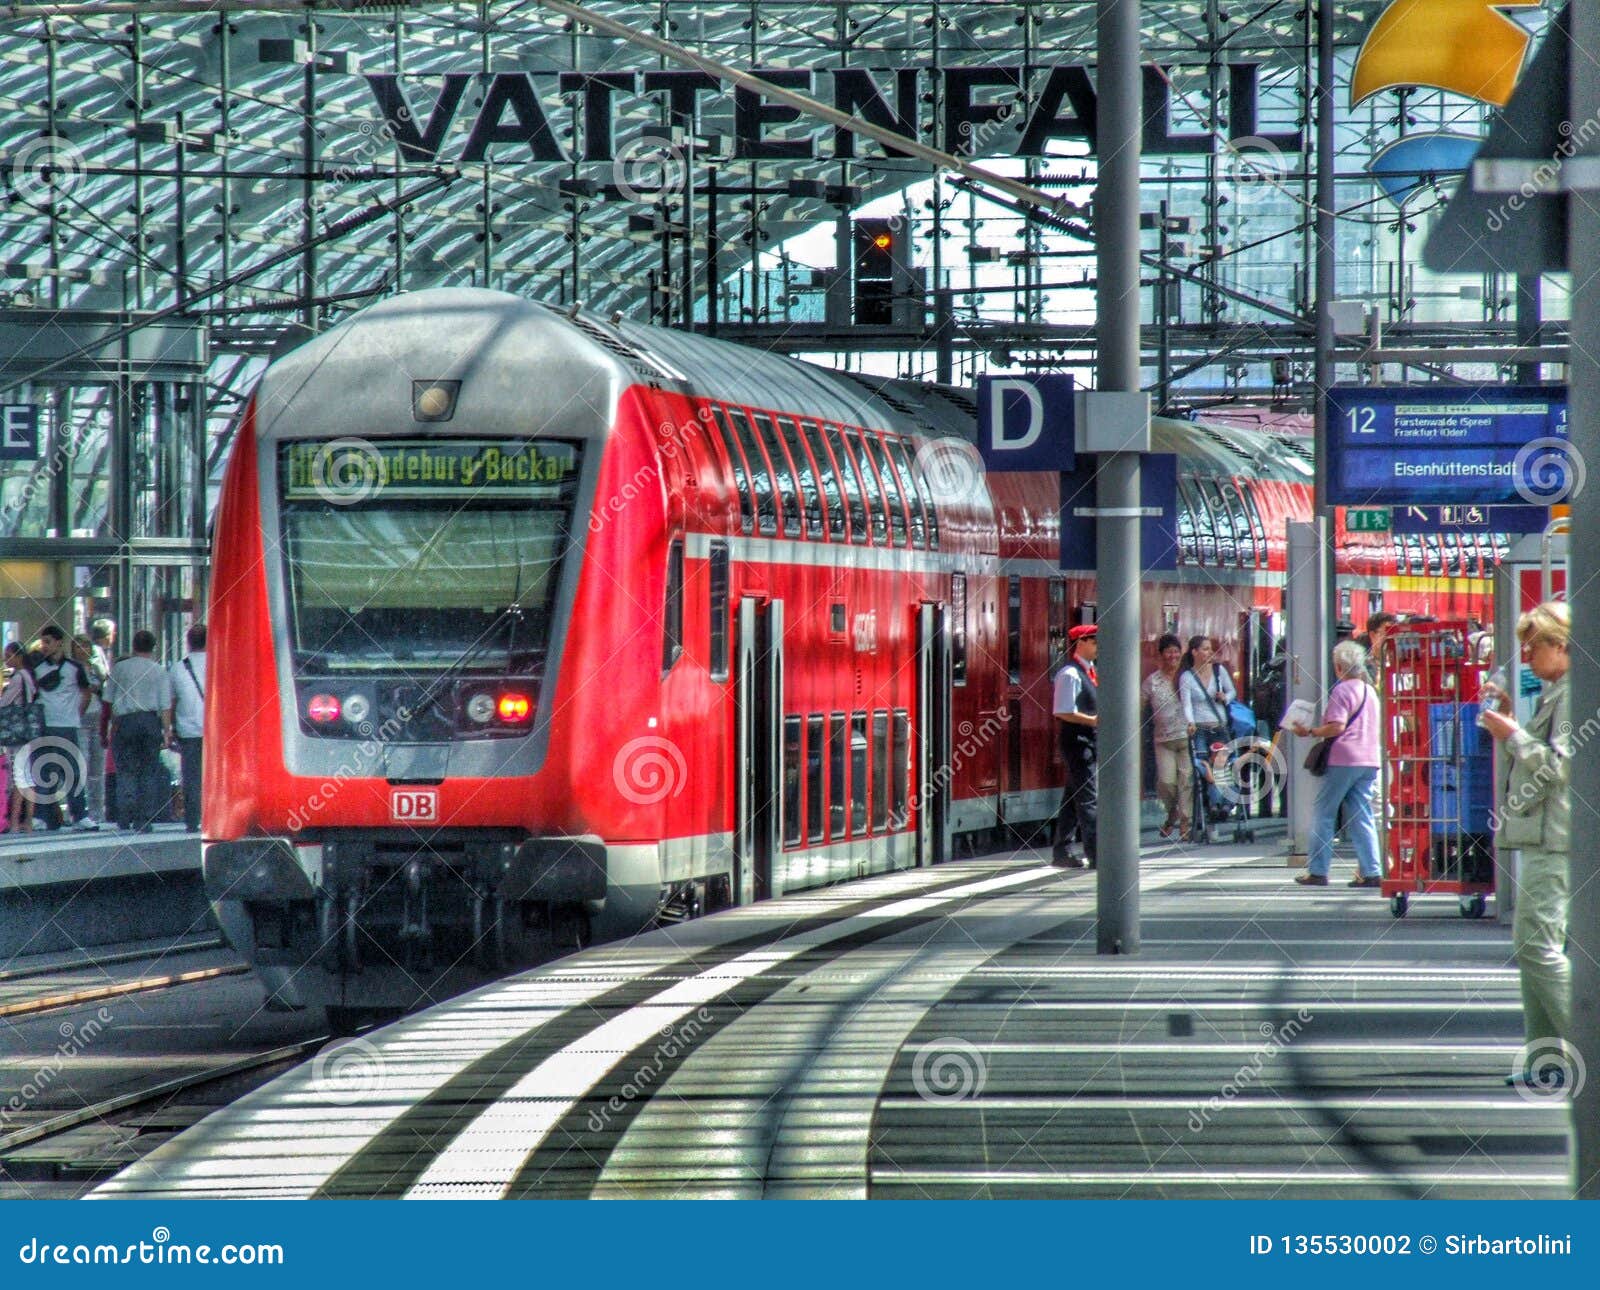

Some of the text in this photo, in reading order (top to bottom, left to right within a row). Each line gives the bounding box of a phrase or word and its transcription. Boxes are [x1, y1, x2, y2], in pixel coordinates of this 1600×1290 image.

[362, 63, 1304, 163] VATTENFALL
[3, 406, 31, 448] E
[991, 379, 1044, 450] D
[1346, 406, 1377, 434] 12
[1394, 427, 1468, 439] Frankfurt (Oder)
[1394, 461, 1518, 477] Eisenhüttenstadt
[397, 794, 433, 817] DB
